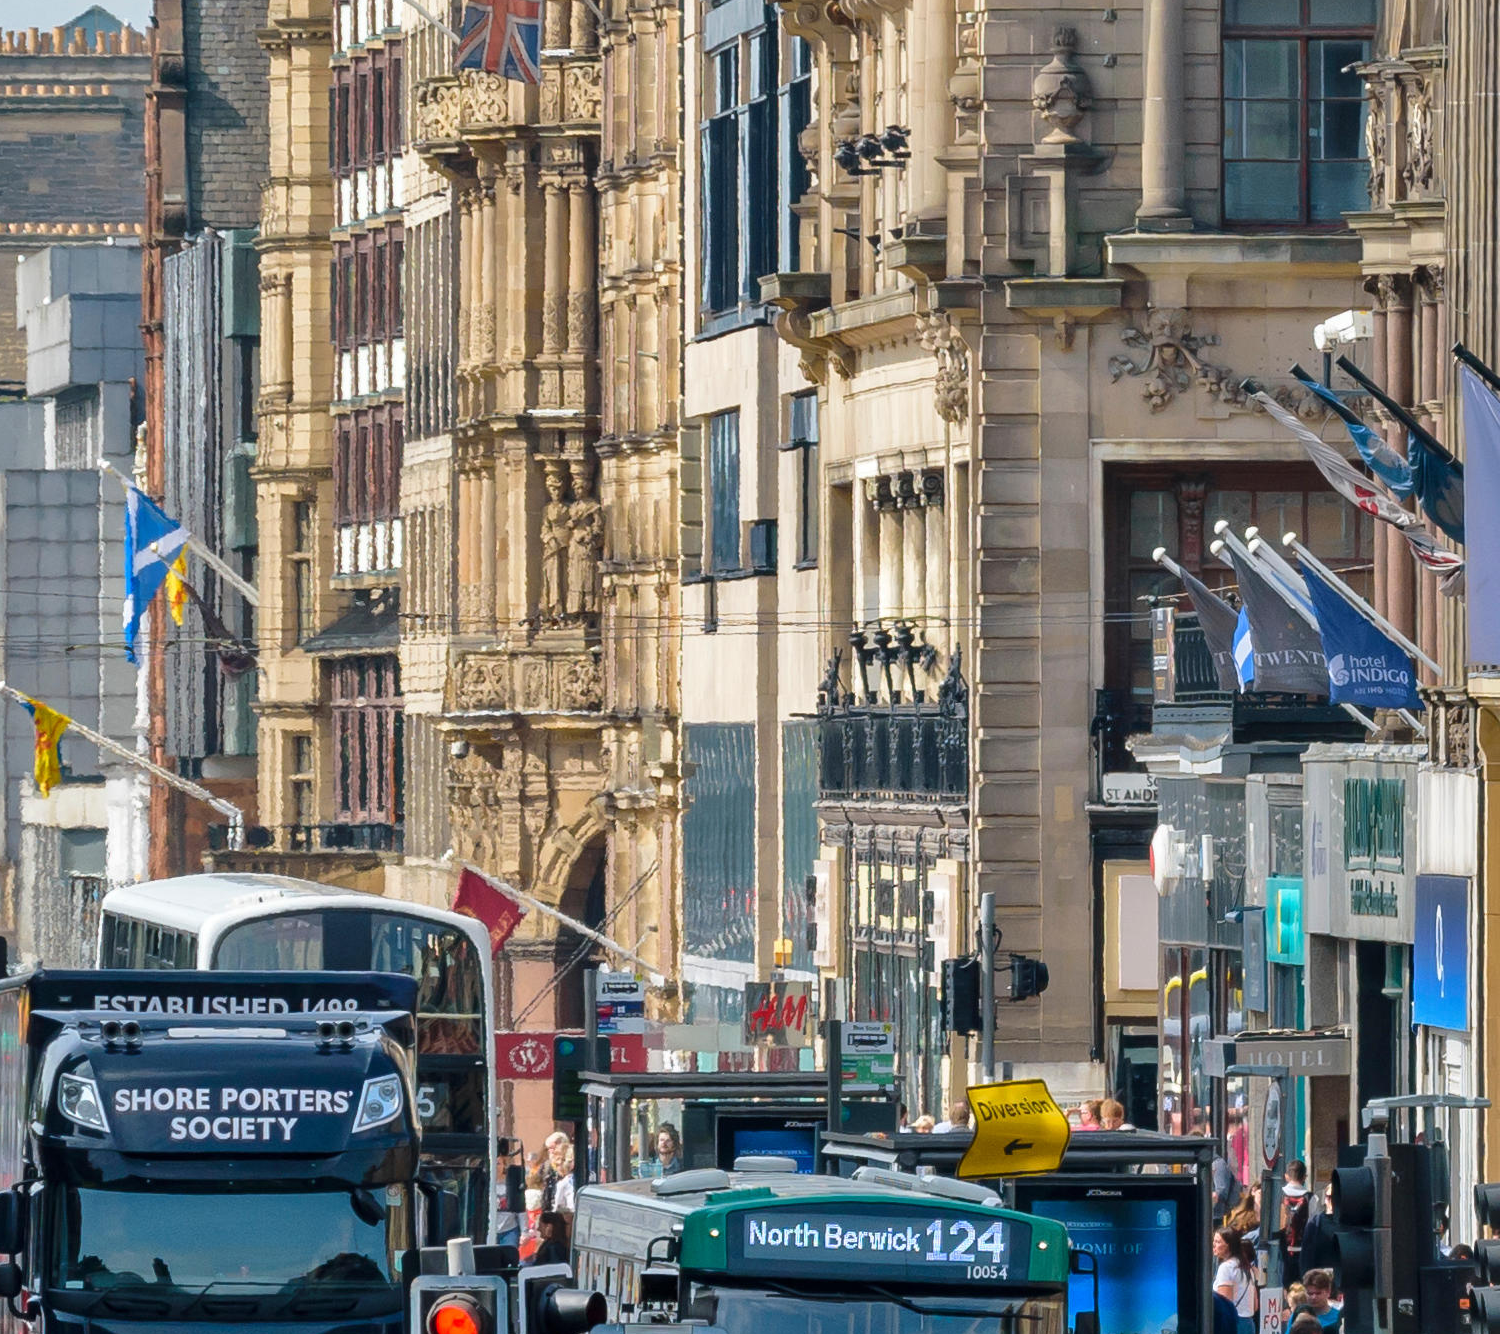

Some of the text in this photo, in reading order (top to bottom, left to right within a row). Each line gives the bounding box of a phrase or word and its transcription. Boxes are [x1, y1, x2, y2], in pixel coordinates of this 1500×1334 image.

[1350, 655, 1386, 668] hotel
[1352, 668, 1409, 684] INDIGO
[1106, 789, 1120, 801] ST
[751, 994, 807, 1032] H&M
[1248, 1050, 1332, 1067] HOTEL
[115, 1088, 211, 1113] SHORE
[977, 1097, 1054, 1123] Diversion
[171, 1117, 298, 1141] SOCIETY
[749, 1219, 1005, 1264] North Berwick 124
[1123, 1242, 1143, 1255] OF
[966, 1264, 1009, 1280] 10054
